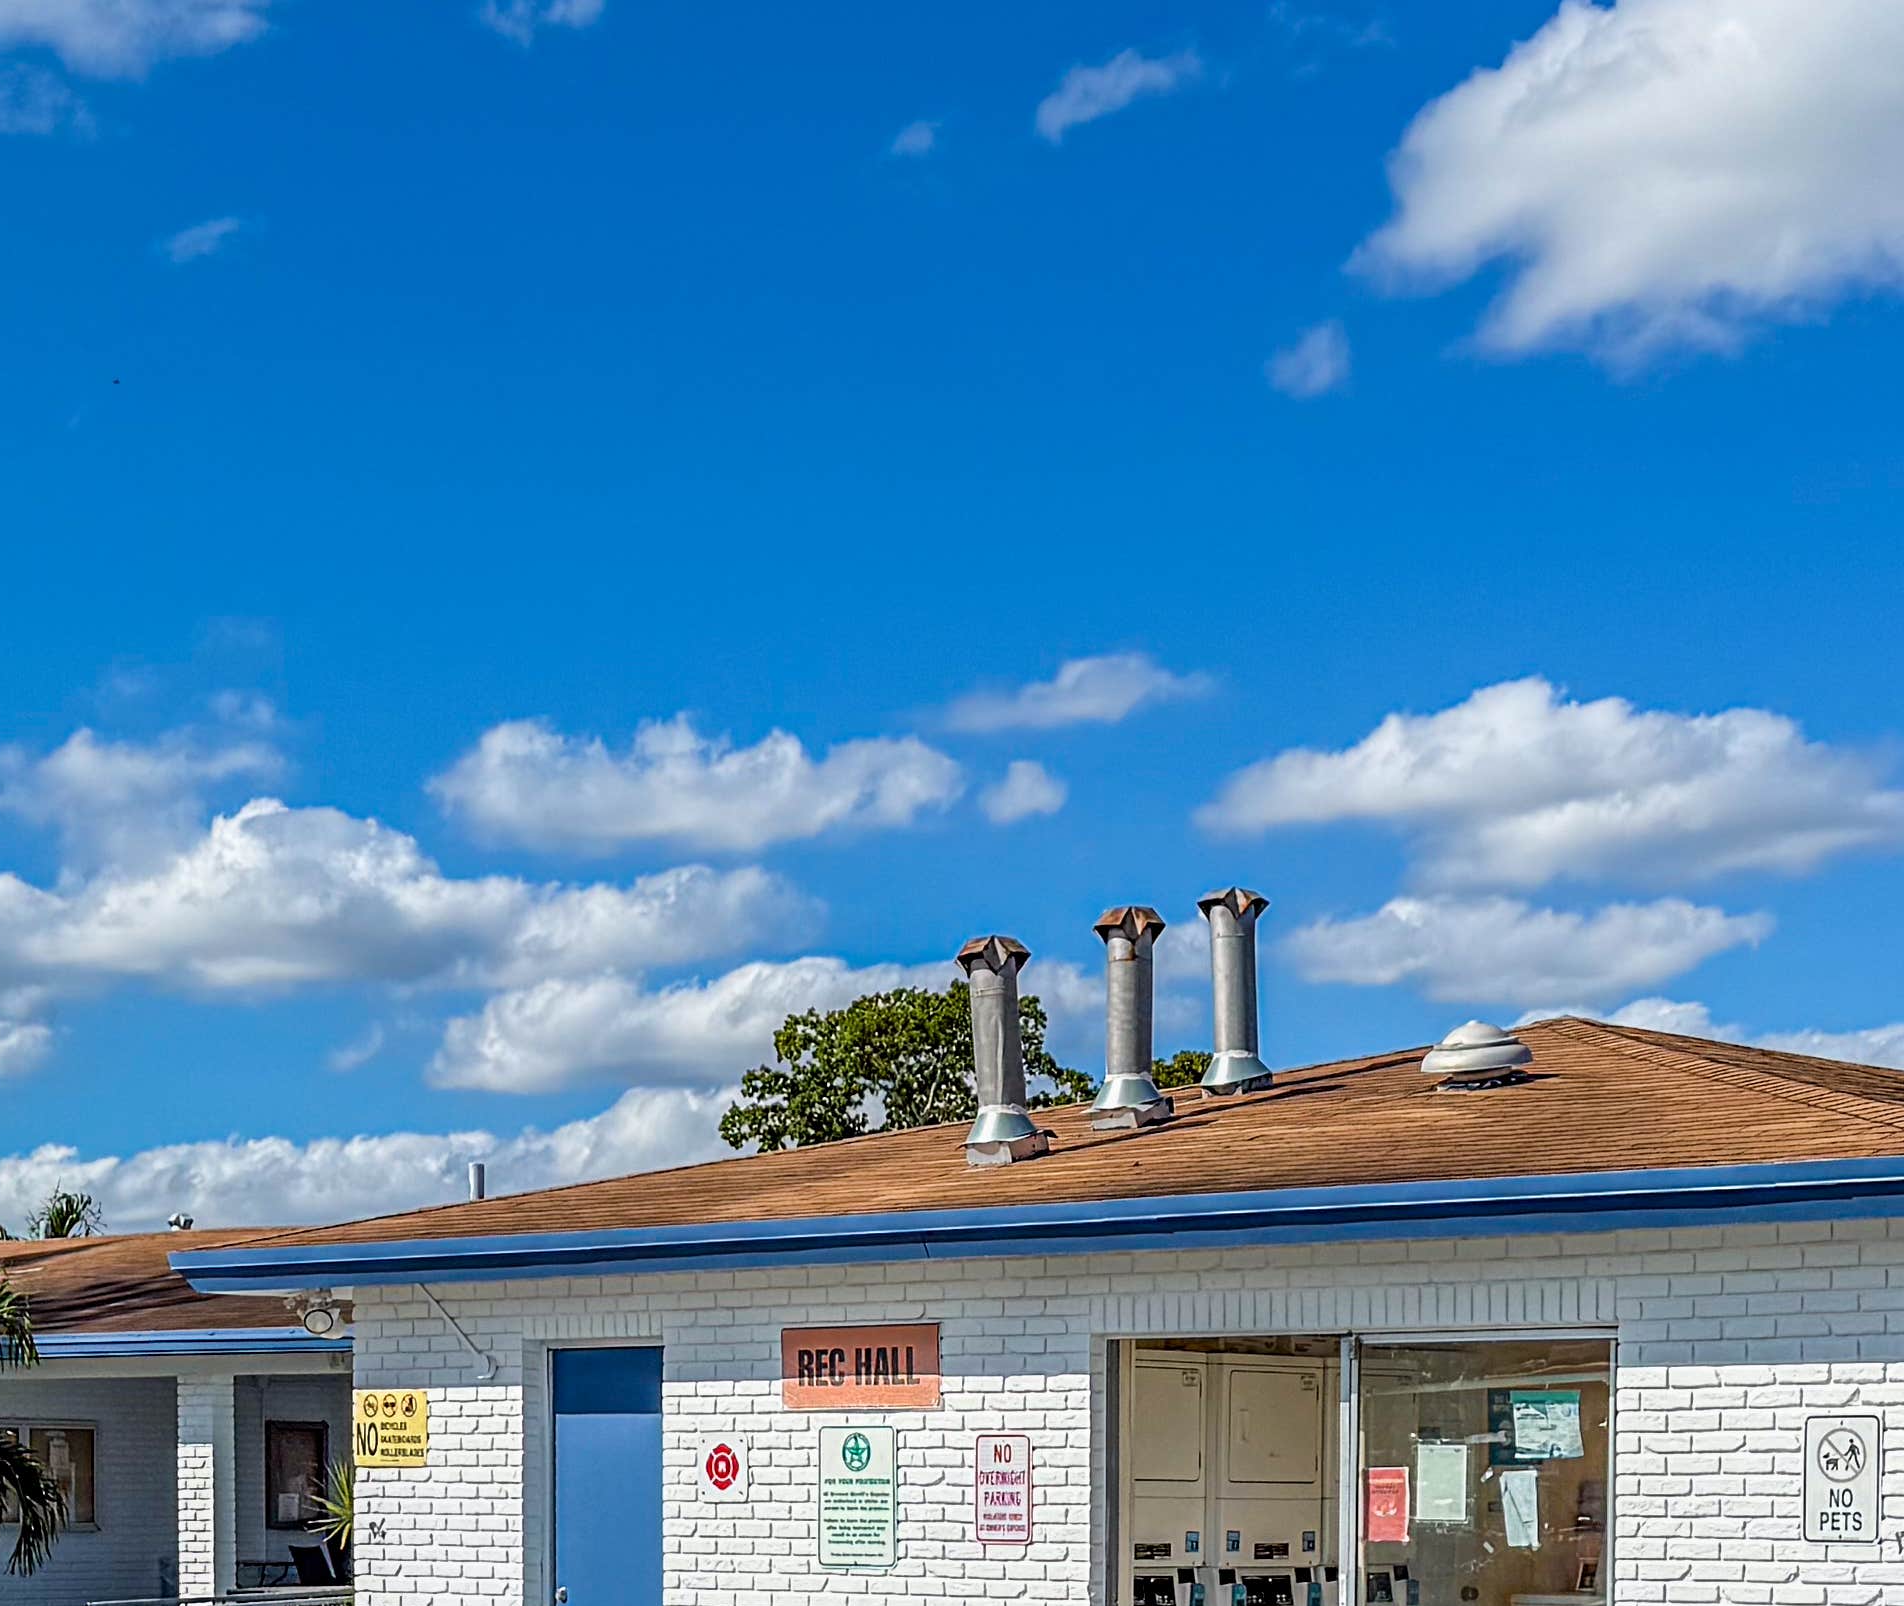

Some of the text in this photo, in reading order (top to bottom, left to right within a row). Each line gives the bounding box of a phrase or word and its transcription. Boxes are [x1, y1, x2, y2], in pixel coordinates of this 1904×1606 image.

[798, 1346, 921, 1387] REC HALL
[356, 1422, 378, 1456] NO
[993, 1443, 1012, 1463] NO
[979, 1470, 1026, 1485] OVERNIGHT
[984, 1491, 1021, 1507] PARKING
[1829, 1488, 1853, 1508] NO
[1819, 1511, 1863, 1531] PETS
